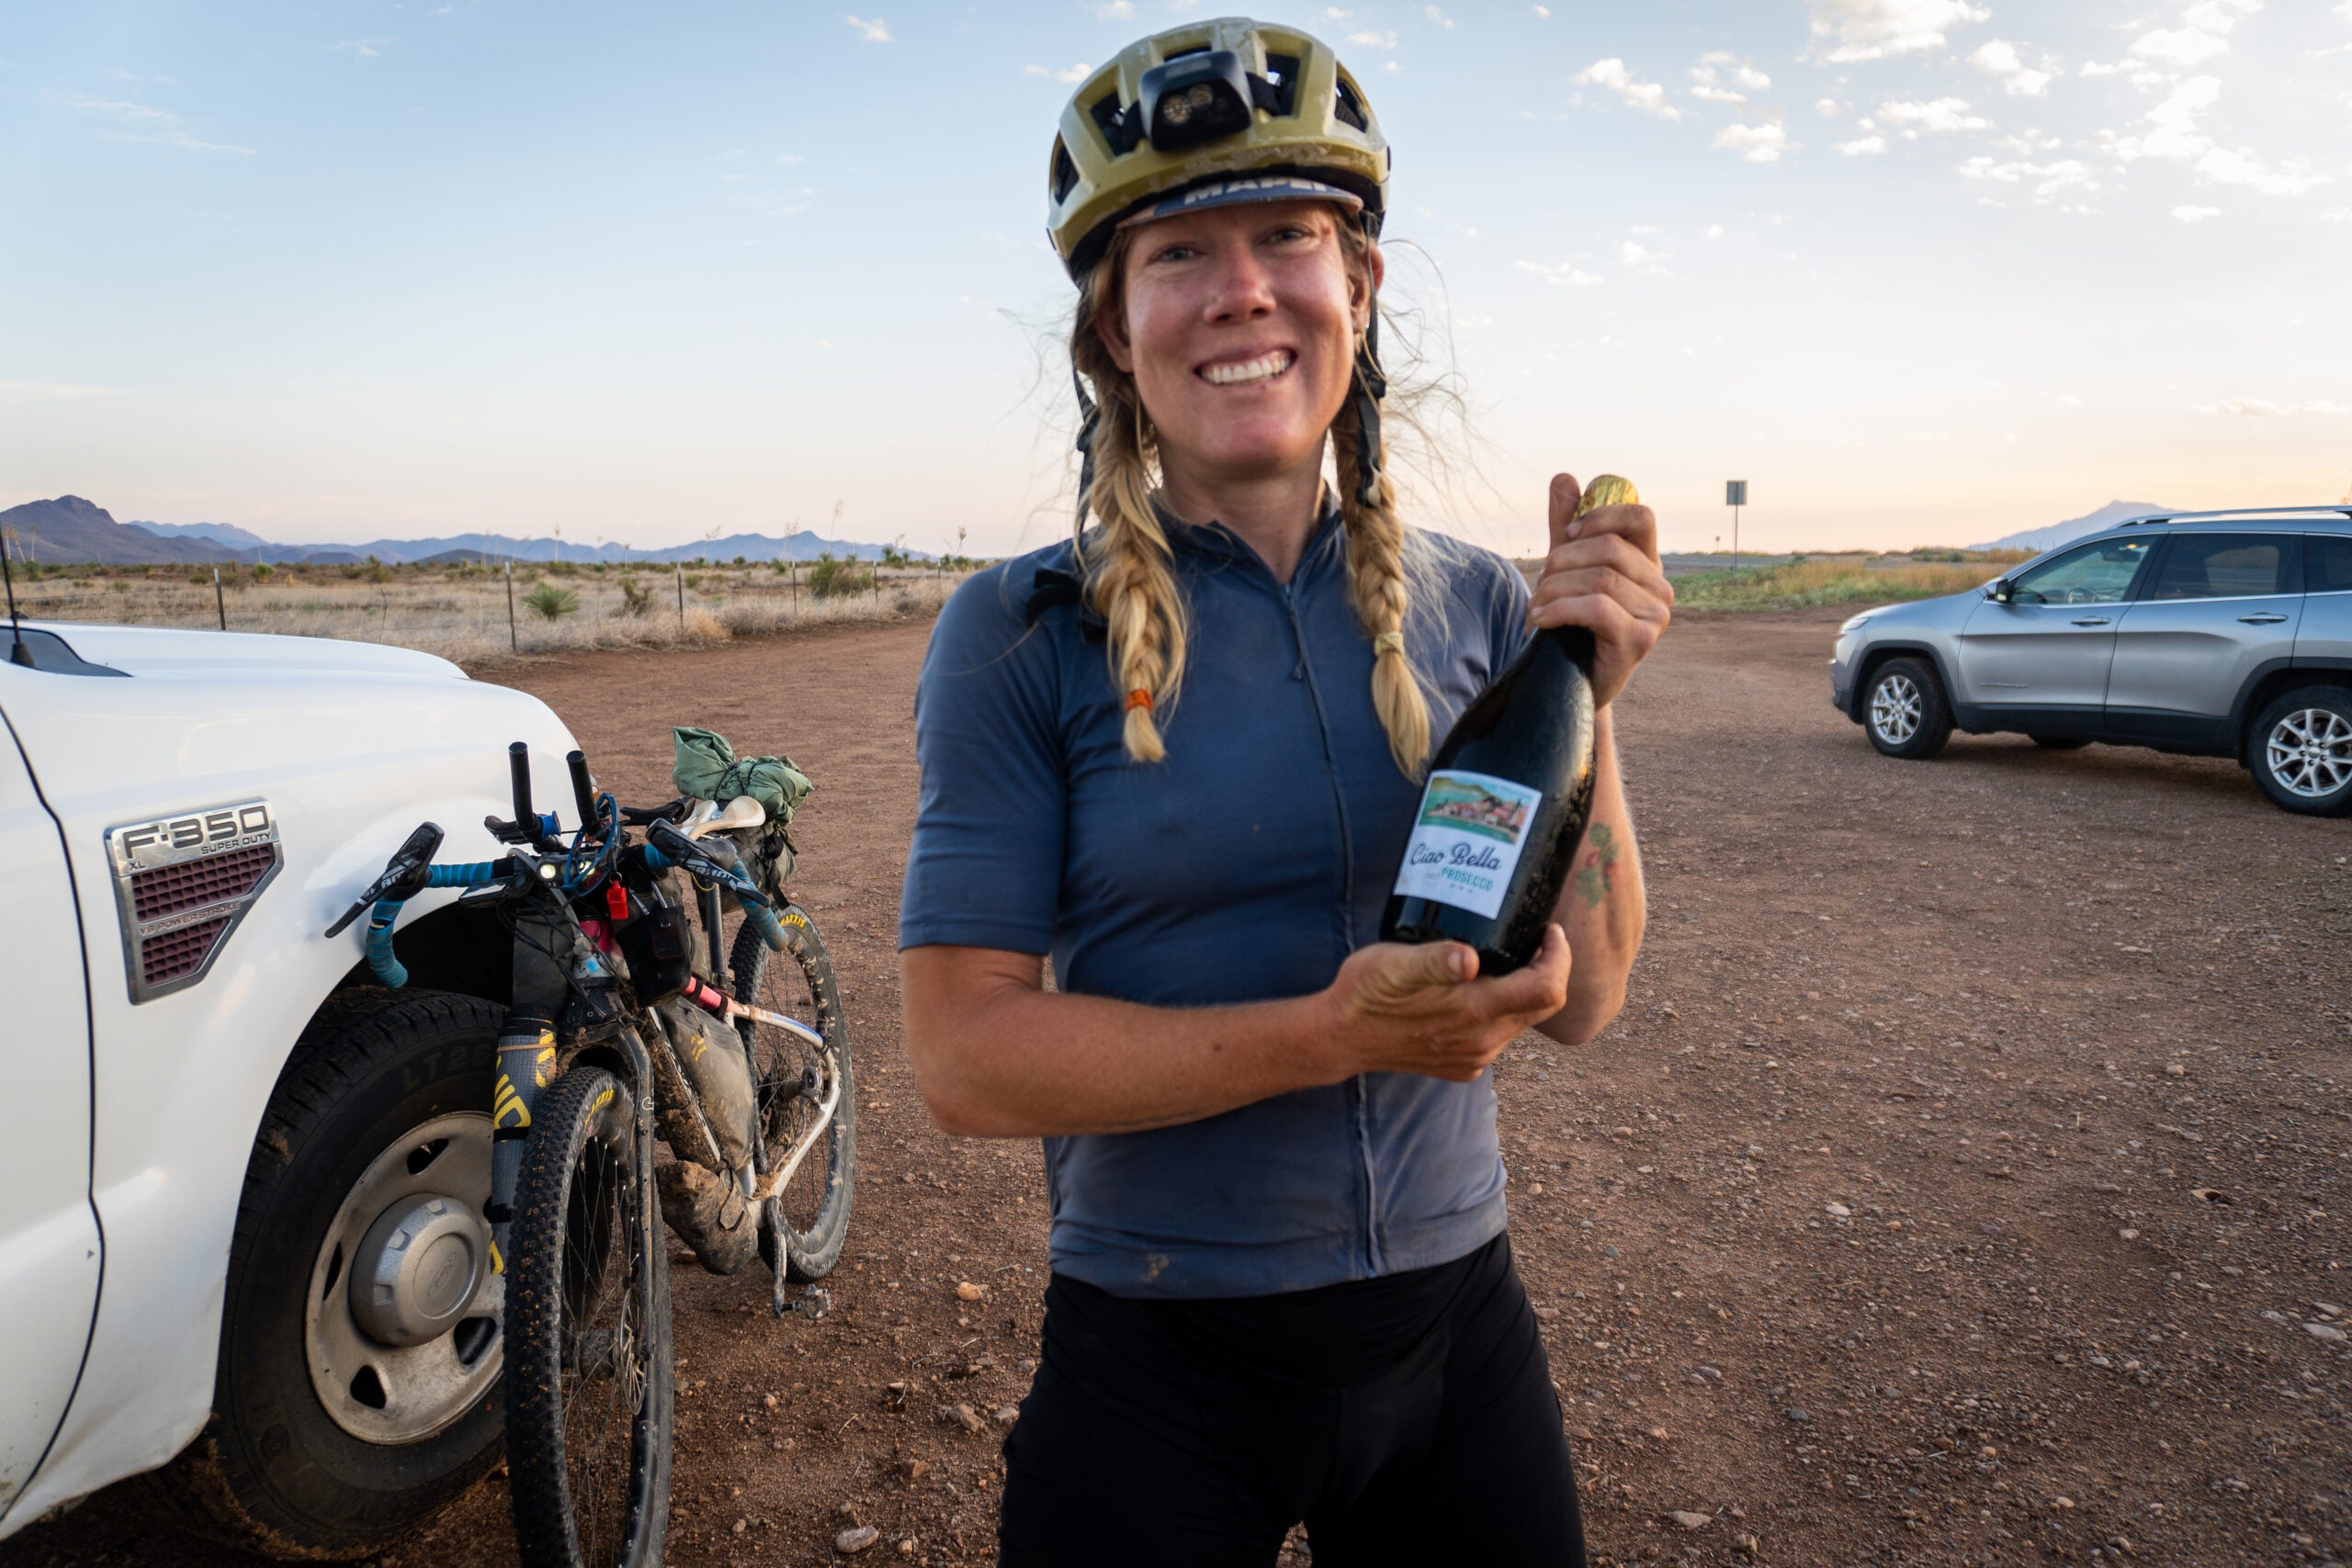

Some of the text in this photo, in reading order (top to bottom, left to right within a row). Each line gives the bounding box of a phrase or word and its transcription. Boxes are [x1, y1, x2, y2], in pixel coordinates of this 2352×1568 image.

[200, 832, 272, 855] SUPER DUTY
[1410, 841, 1502, 872] Ciao Bella
[128, 861, 147, 871] XL
[1442, 866, 1494, 892] PROSECCO
[139, 925, 155, 935] V8
[198, 902, 241, 919] STROKE
